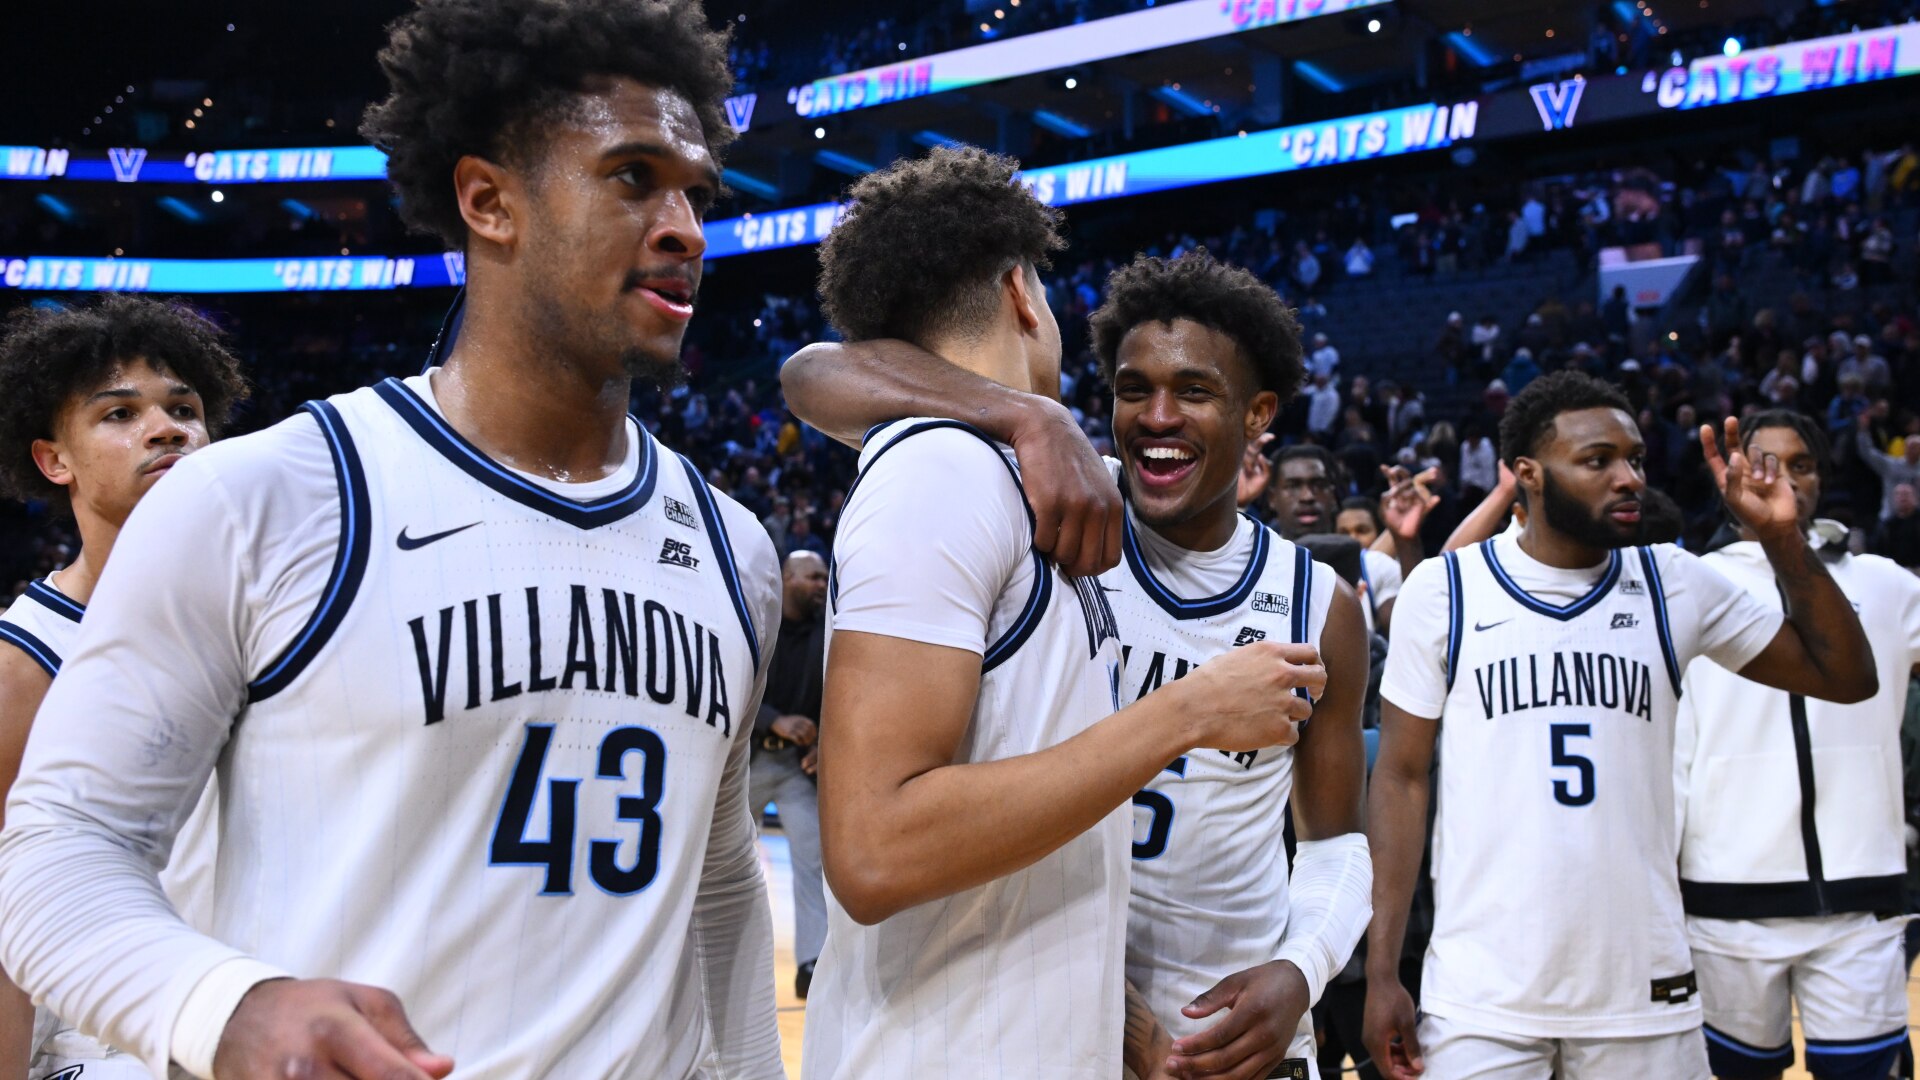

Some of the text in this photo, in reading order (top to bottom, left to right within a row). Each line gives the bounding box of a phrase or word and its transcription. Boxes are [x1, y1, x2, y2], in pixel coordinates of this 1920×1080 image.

[1802, 37, 1897, 84] WIN
[878, 62, 932, 98] WIN
[1402, 101, 1479, 147] WIN
[7, 148, 69, 176] WIN
[278, 150, 333, 178] WIN
[1065, 160, 1127, 199] WIN
[93, 260, 151, 288] WIN
[361, 258, 415, 285] WIN
[664, 496, 678, 511] BE
[660, 548, 700, 568] EAST
[663, 537, 691, 556] BIG
[1252, 600, 1289, 616] CHANGE
[1255, 592, 1288, 605] BE THE
[1240, 626, 1266, 639] BIG
[408, 584, 730, 738] VILLANOVA
[1475, 651, 1652, 722] VILLANOVA
[1549, 723, 1596, 808] 5
[487, 723, 668, 897] 43
